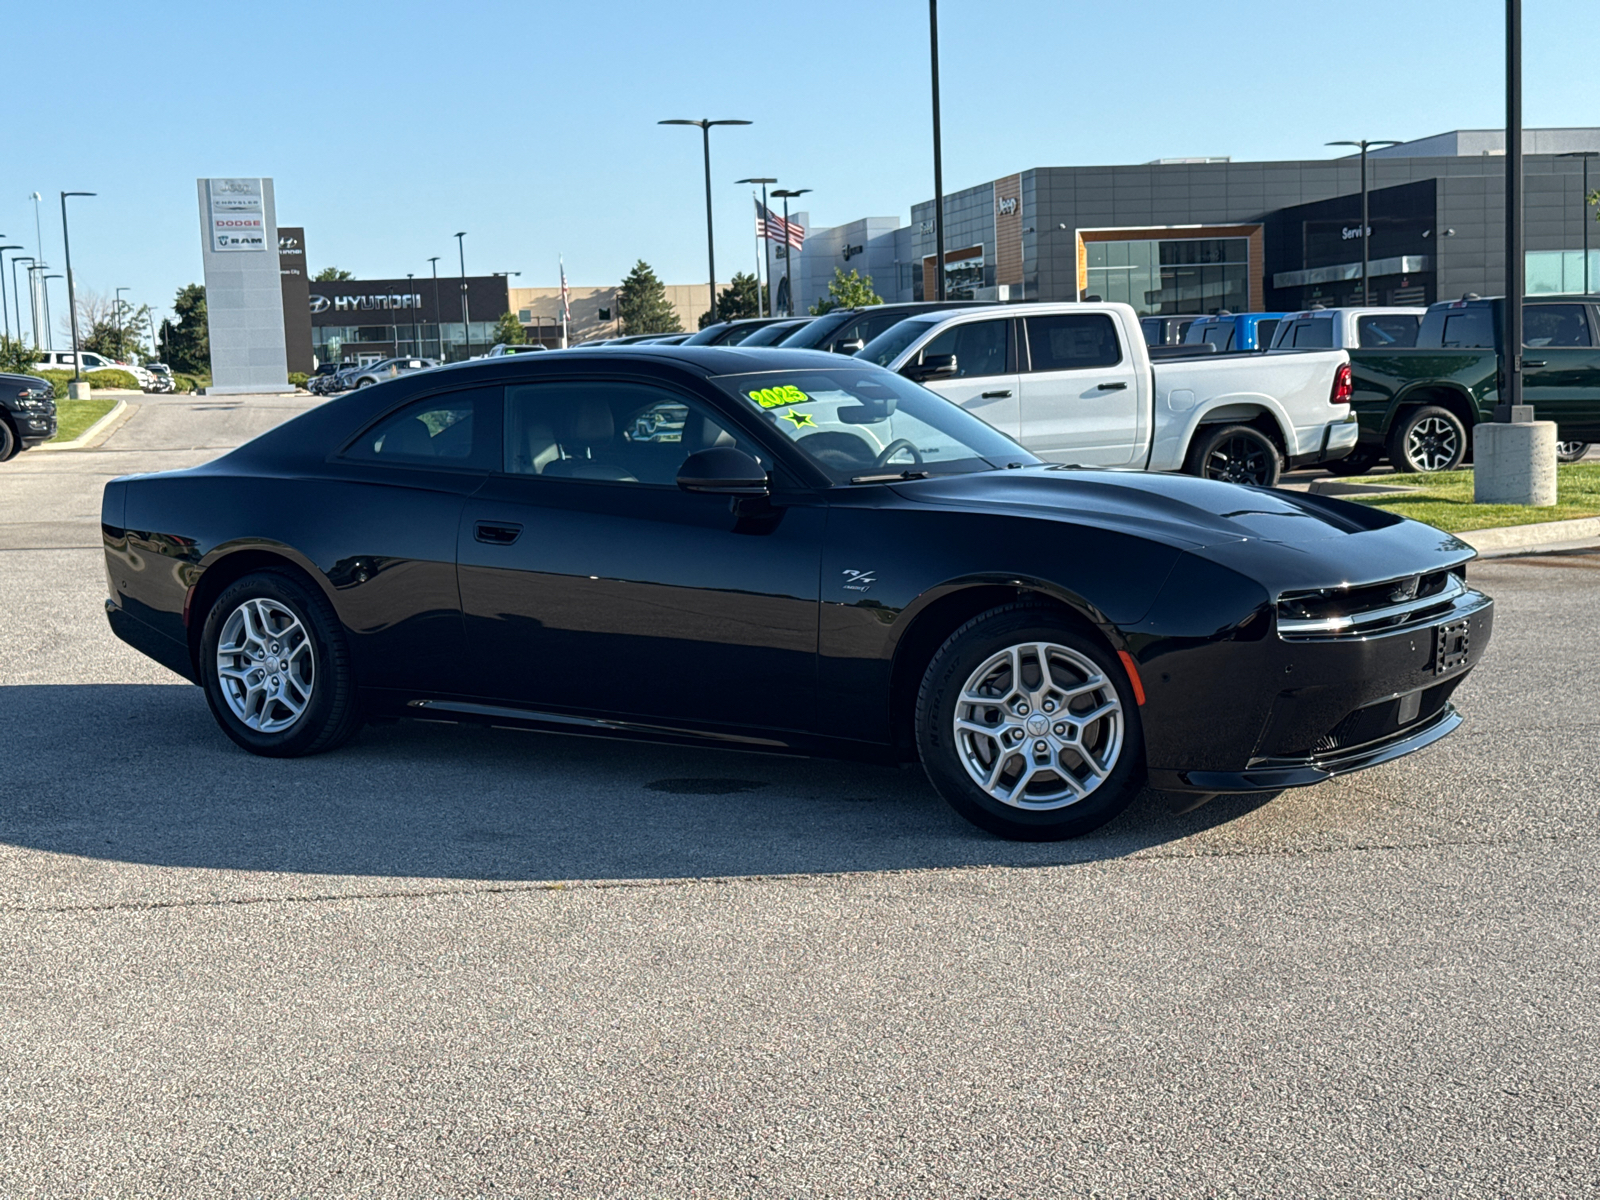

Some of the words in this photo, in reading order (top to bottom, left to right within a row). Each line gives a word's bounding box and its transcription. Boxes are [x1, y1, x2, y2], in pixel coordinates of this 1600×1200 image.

[220, 181, 251, 194] Jeep
[997, 196, 1018, 216] Jeep
[1341, 224, 1372, 240] Servie
[334, 293, 421, 311] HYUNDAI
[748, 385, 809, 408] 2025
[842, 569, 877, 583] R/T
